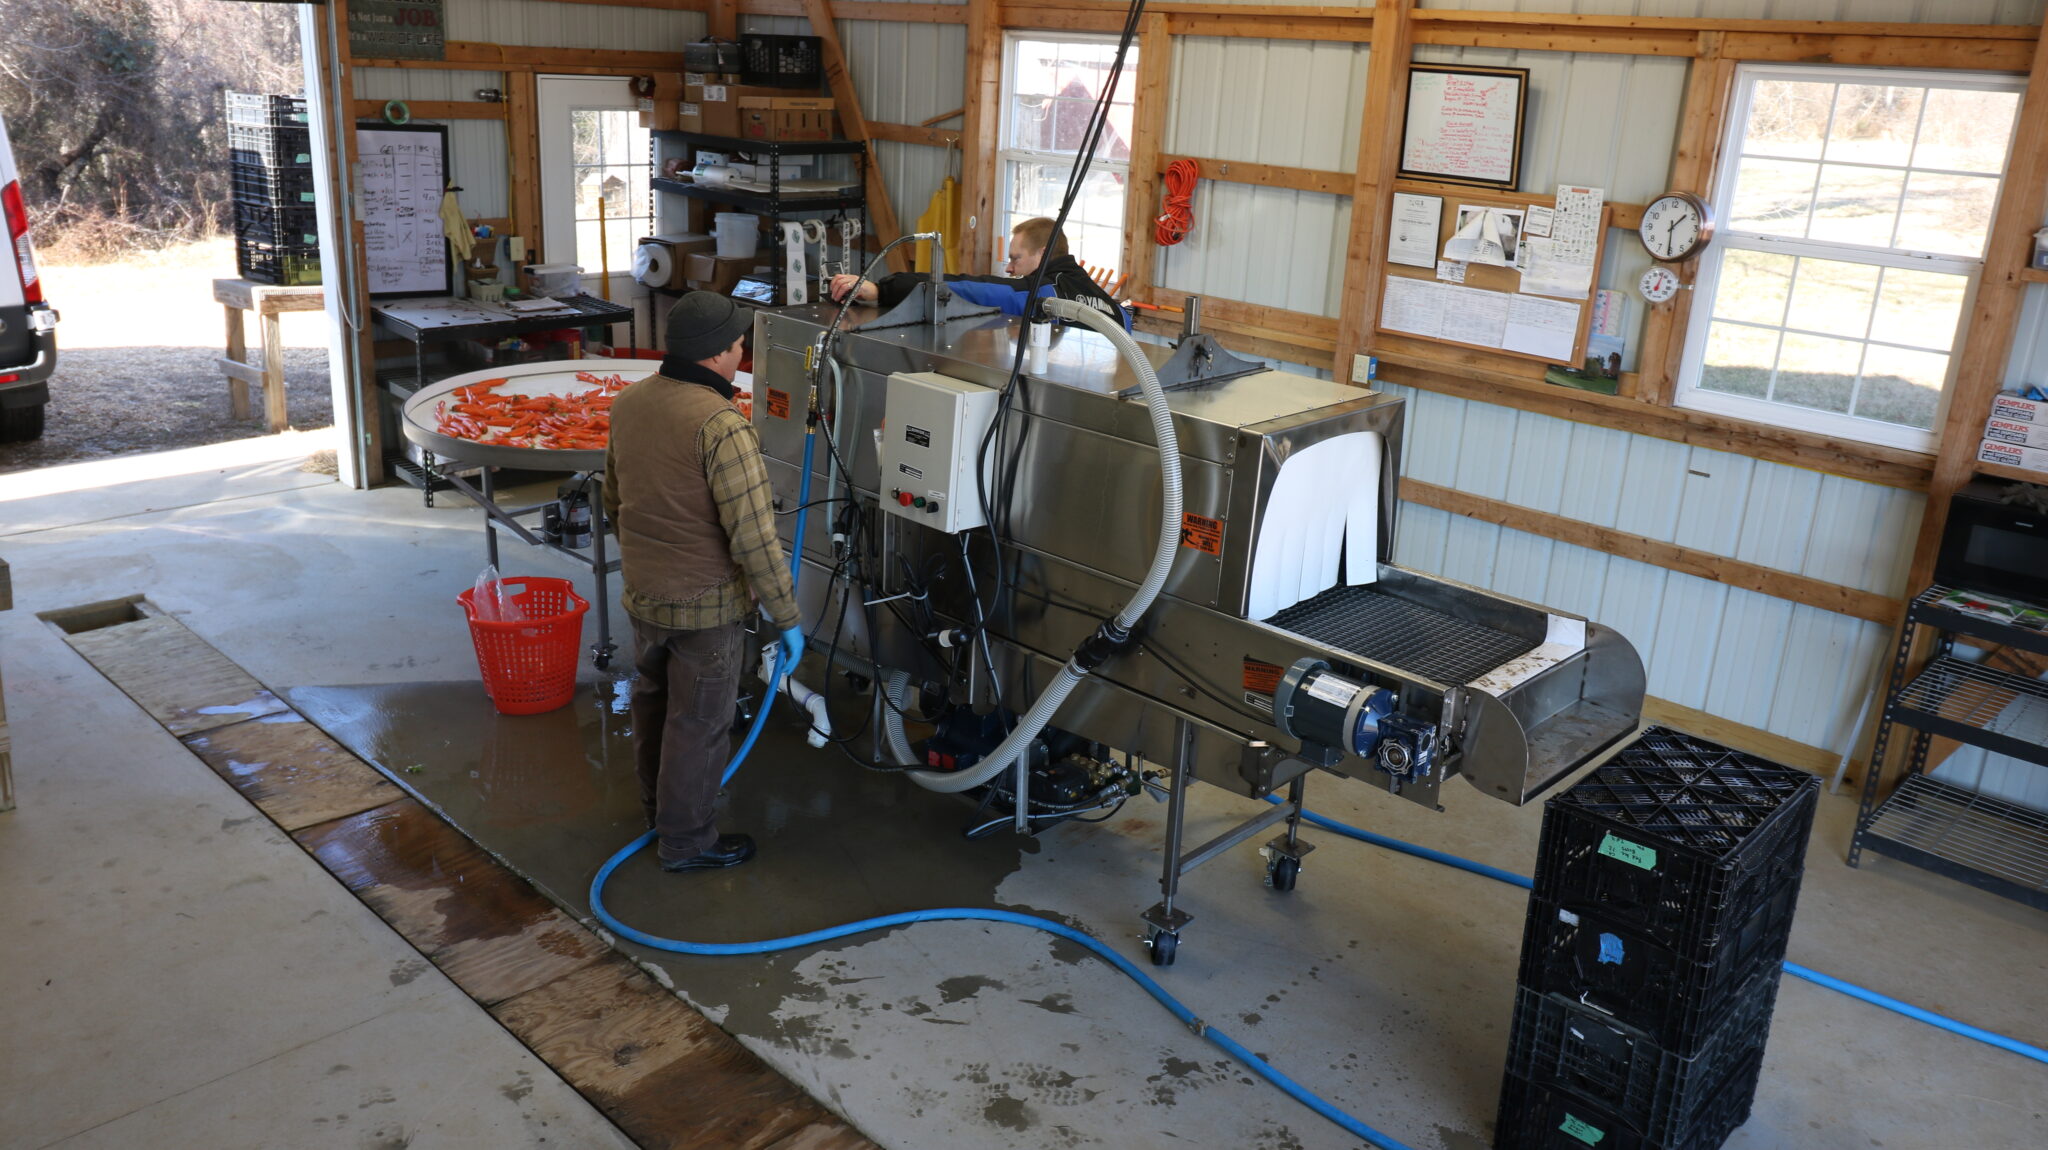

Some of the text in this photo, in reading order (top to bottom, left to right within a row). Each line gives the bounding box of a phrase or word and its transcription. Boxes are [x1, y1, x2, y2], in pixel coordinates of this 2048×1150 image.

[395, 8, 438, 27] JOB
[399, 32, 415, 45] OF
[416, 33, 441, 46] LIFE
[1661, 202, 1667, 211] 11
[1652, 212, 1660, 220] 10
[1691, 213, 1697, 221] 2
[1186, 514, 1218, 530] WARNING
[1244, 665, 1280, 675] WARNING
